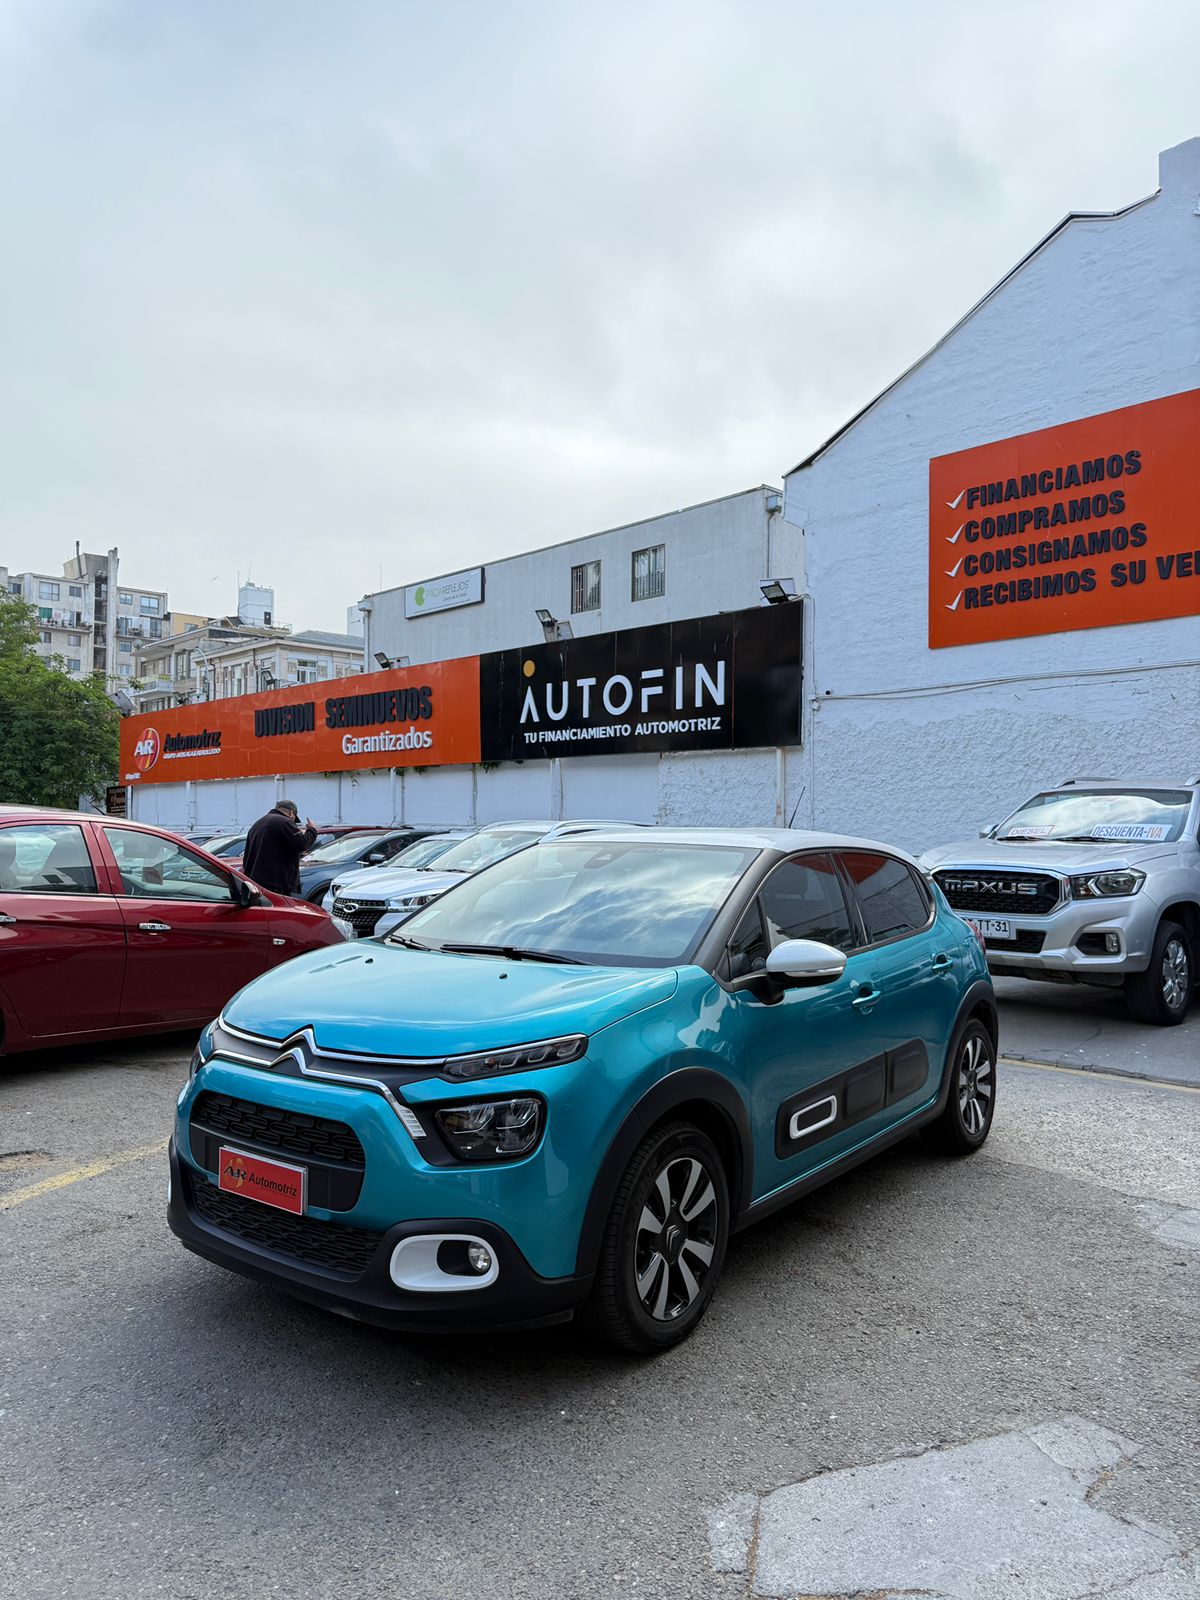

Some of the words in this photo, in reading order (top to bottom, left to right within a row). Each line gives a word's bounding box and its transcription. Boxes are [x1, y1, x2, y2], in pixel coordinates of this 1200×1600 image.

[966, 450, 1142, 509] FINANCIAMOS
[964, 490, 1126, 543] COMPRAMOS
[963, 522, 1147, 577] CONSIGNAMOS
[964, 568, 1096, 609] RECIBIMOS
[1110, 559, 1146, 587] SU
[255, 702, 315, 737] DIVISION
[325, 686, 432, 728] SEMINUEVOS
[519, 660, 725, 724] AUTOFIN
[163, 729, 221, 752] Automotriz
[342, 726, 432, 755] Garantizados
[524, 732, 537, 744] TU
[538, 724, 631, 743] FINANCIAMIENTO
[634, 716, 721, 736] AUTOMOTRIZ
[1010, 827, 1047, 836] DIESEL
[944, 879, 1038, 895] MAXUS
[248, 1172, 298, 1197] Automotriz
